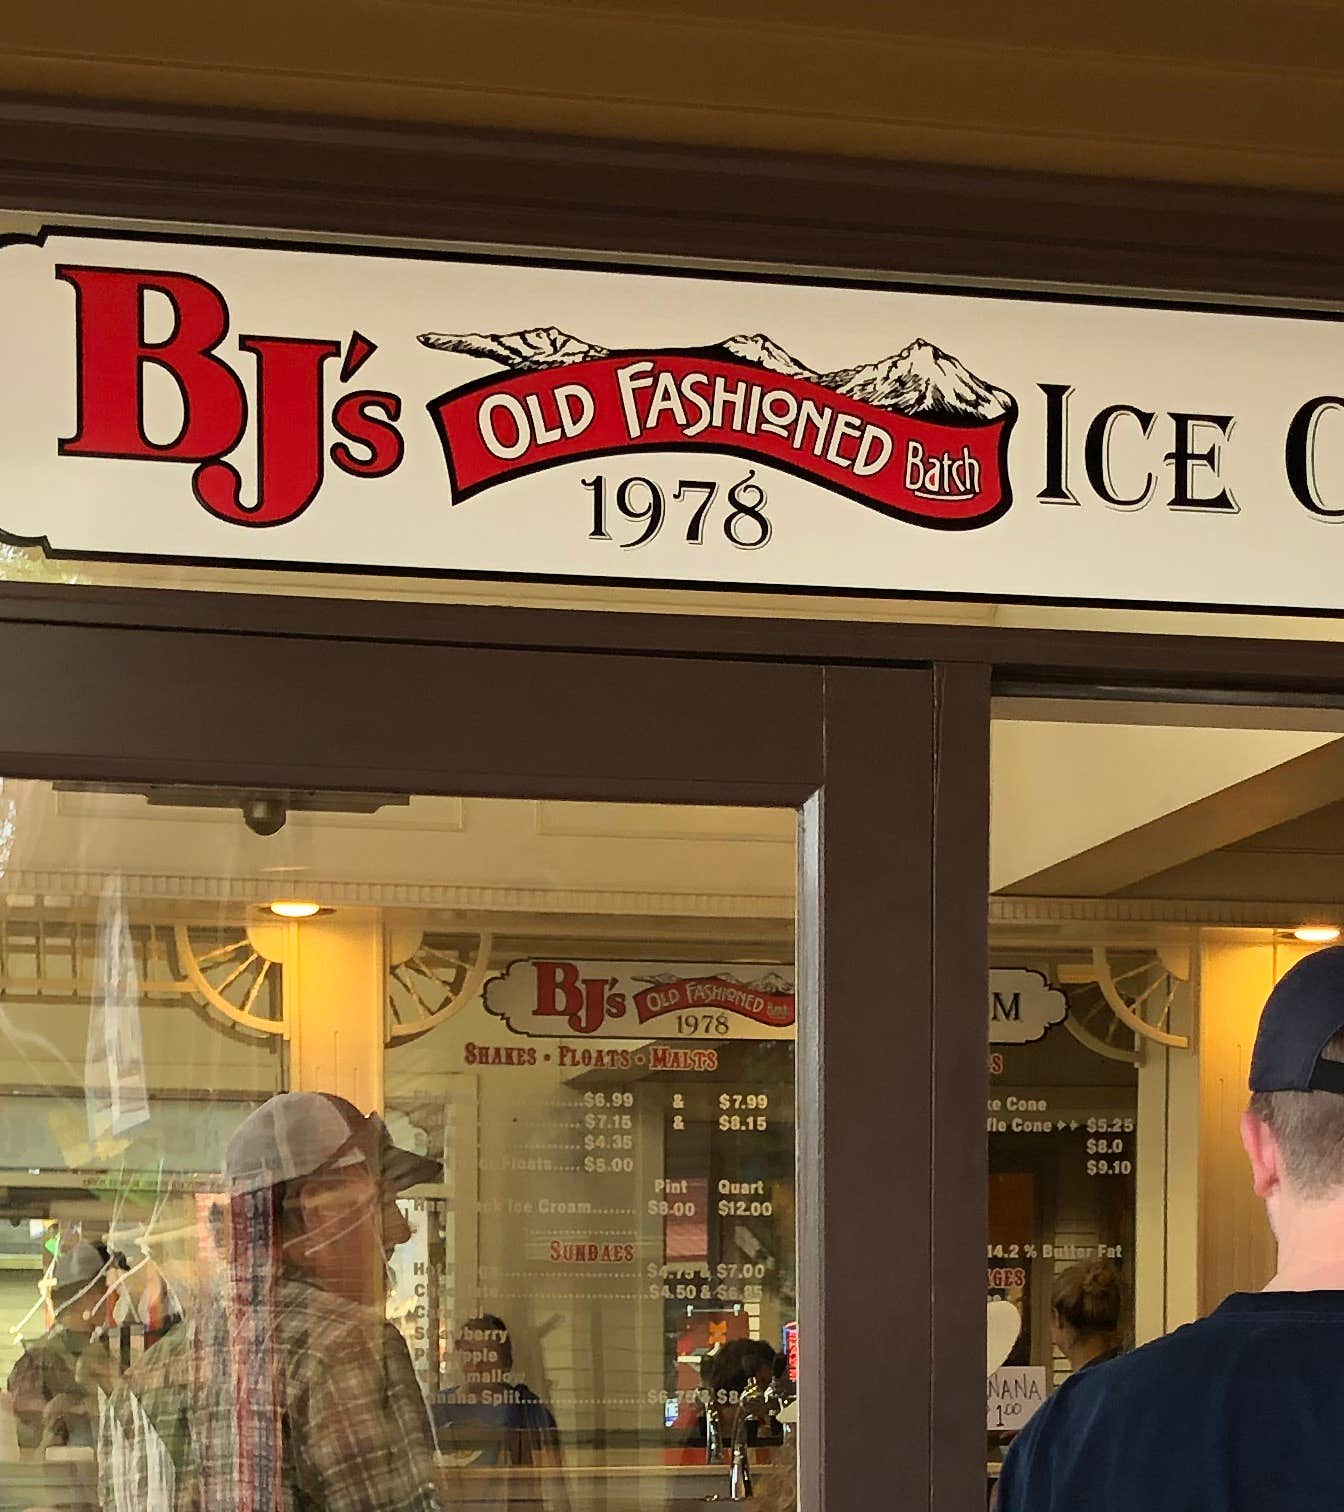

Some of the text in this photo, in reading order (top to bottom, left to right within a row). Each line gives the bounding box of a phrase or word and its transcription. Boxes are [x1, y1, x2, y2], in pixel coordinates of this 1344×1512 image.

[55, 263, 403, 528] BJ's
[477, 384, 596, 461] OLD
[618, 360, 893, 477] FASHIONED
[905, 442, 981, 502] Batch
[581, 465, 772, 550] 1978
[532, 961, 627, 1034] BJ's
[646, 987, 678, 1011] OLD
[686, 978, 763, 1013] FASHIONED
[677, 1012, 729, 1035] 1978
[583, 1093, 768, 1110] $6.99 & $7.99
[1006, 1096, 1047, 1111] Cone
[583, 1115, 767, 1132] $7.15 & $8.15
[1011, 1117, 1052, 1132] Cone
[1086, 1117, 1134, 1133] $5.25
[583, 1135, 633, 1150] $4.35
[583, 1157, 634, 1172] $5.00
[1087, 1160, 1132, 1176] $9.10
[655, 1179, 764, 1196] Pint Quart
[647, 1201, 696, 1217] $8.00
[718, 1200, 773, 1217] $12.00
[1097, 1244, 1123, 1258] Fat
[716, 1263, 765, 1279] $7.00
[649, 1284, 697, 1300] $4.50
